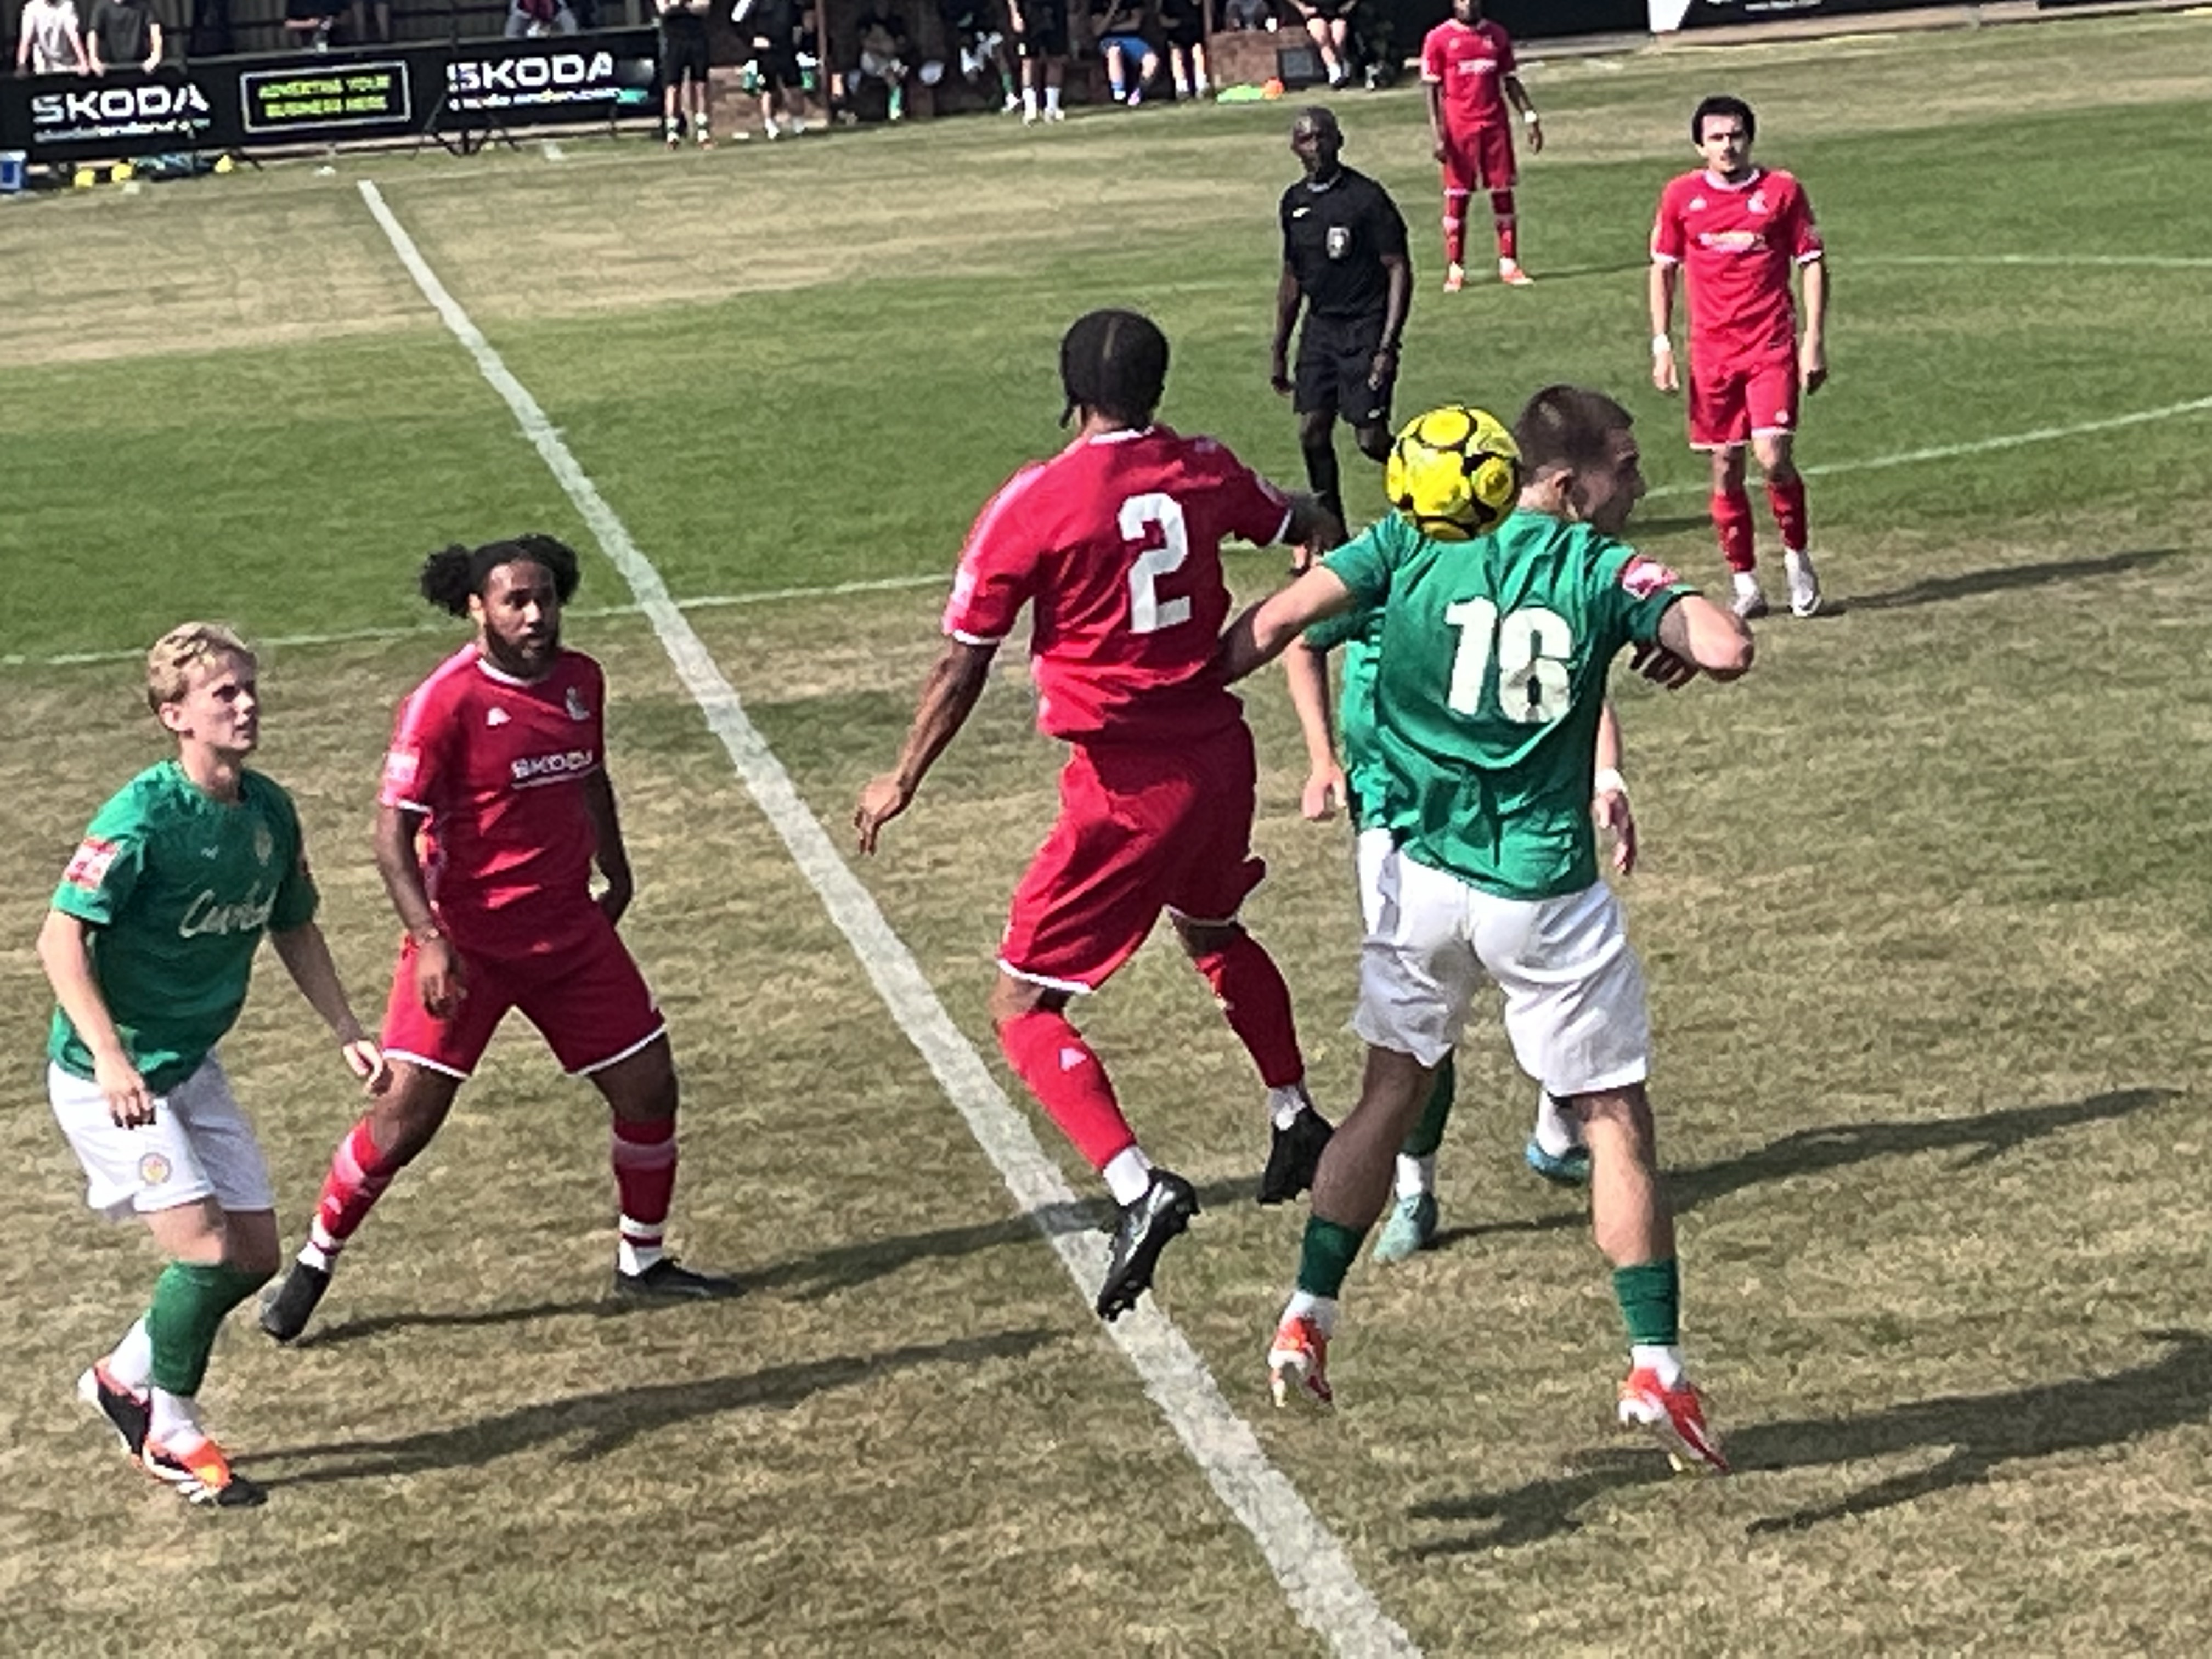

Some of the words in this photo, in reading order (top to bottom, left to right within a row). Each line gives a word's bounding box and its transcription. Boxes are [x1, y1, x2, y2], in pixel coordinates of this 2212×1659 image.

[32, 83, 210, 124] SKODA
[447, 52, 613, 92] SKODA
[1117, 493, 1191, 634] 2
[1444, 595, 1572, 724] 16
